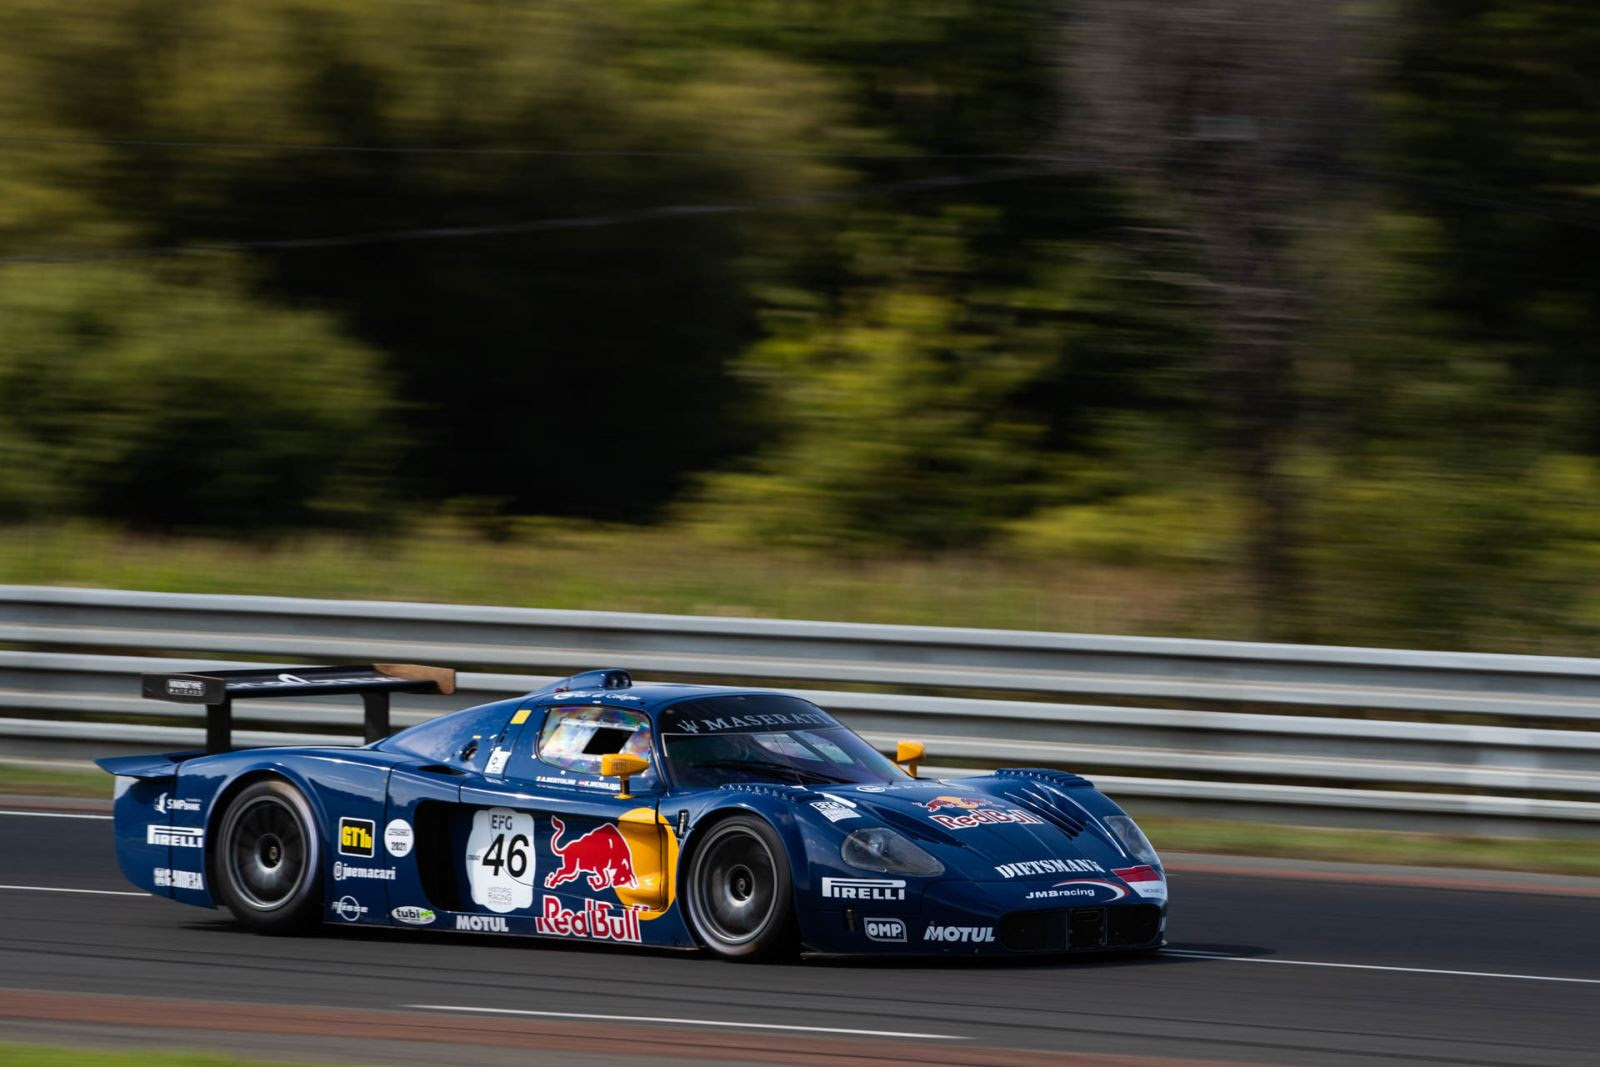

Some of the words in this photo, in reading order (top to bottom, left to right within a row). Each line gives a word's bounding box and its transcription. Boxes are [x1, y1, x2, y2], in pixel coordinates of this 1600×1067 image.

[702, 713, 829, 731] MASERATI
[491, 814, 513, 830] EFG
[928, 809, 1000, 830] Red
[978, 809, 1045, 825] Bull
[147, 824, 205, 848] PIRELLI
[482, 833, 530, 878] 46
[333, 861, 396, 881] @joemacari
[994, 859, 1106, 878] DIETSMANN
[822, 877, 907, 900] PIRELLI
[396, 908, 420, 919] tubi
[535, 895, 592, 937] Red
[590, 899, 645, 943] Bull
[456, 915, 510, 932] MOTUL
[868, 922, 902, 938] OMP
[923, 926, 996, 942] MOTUL
